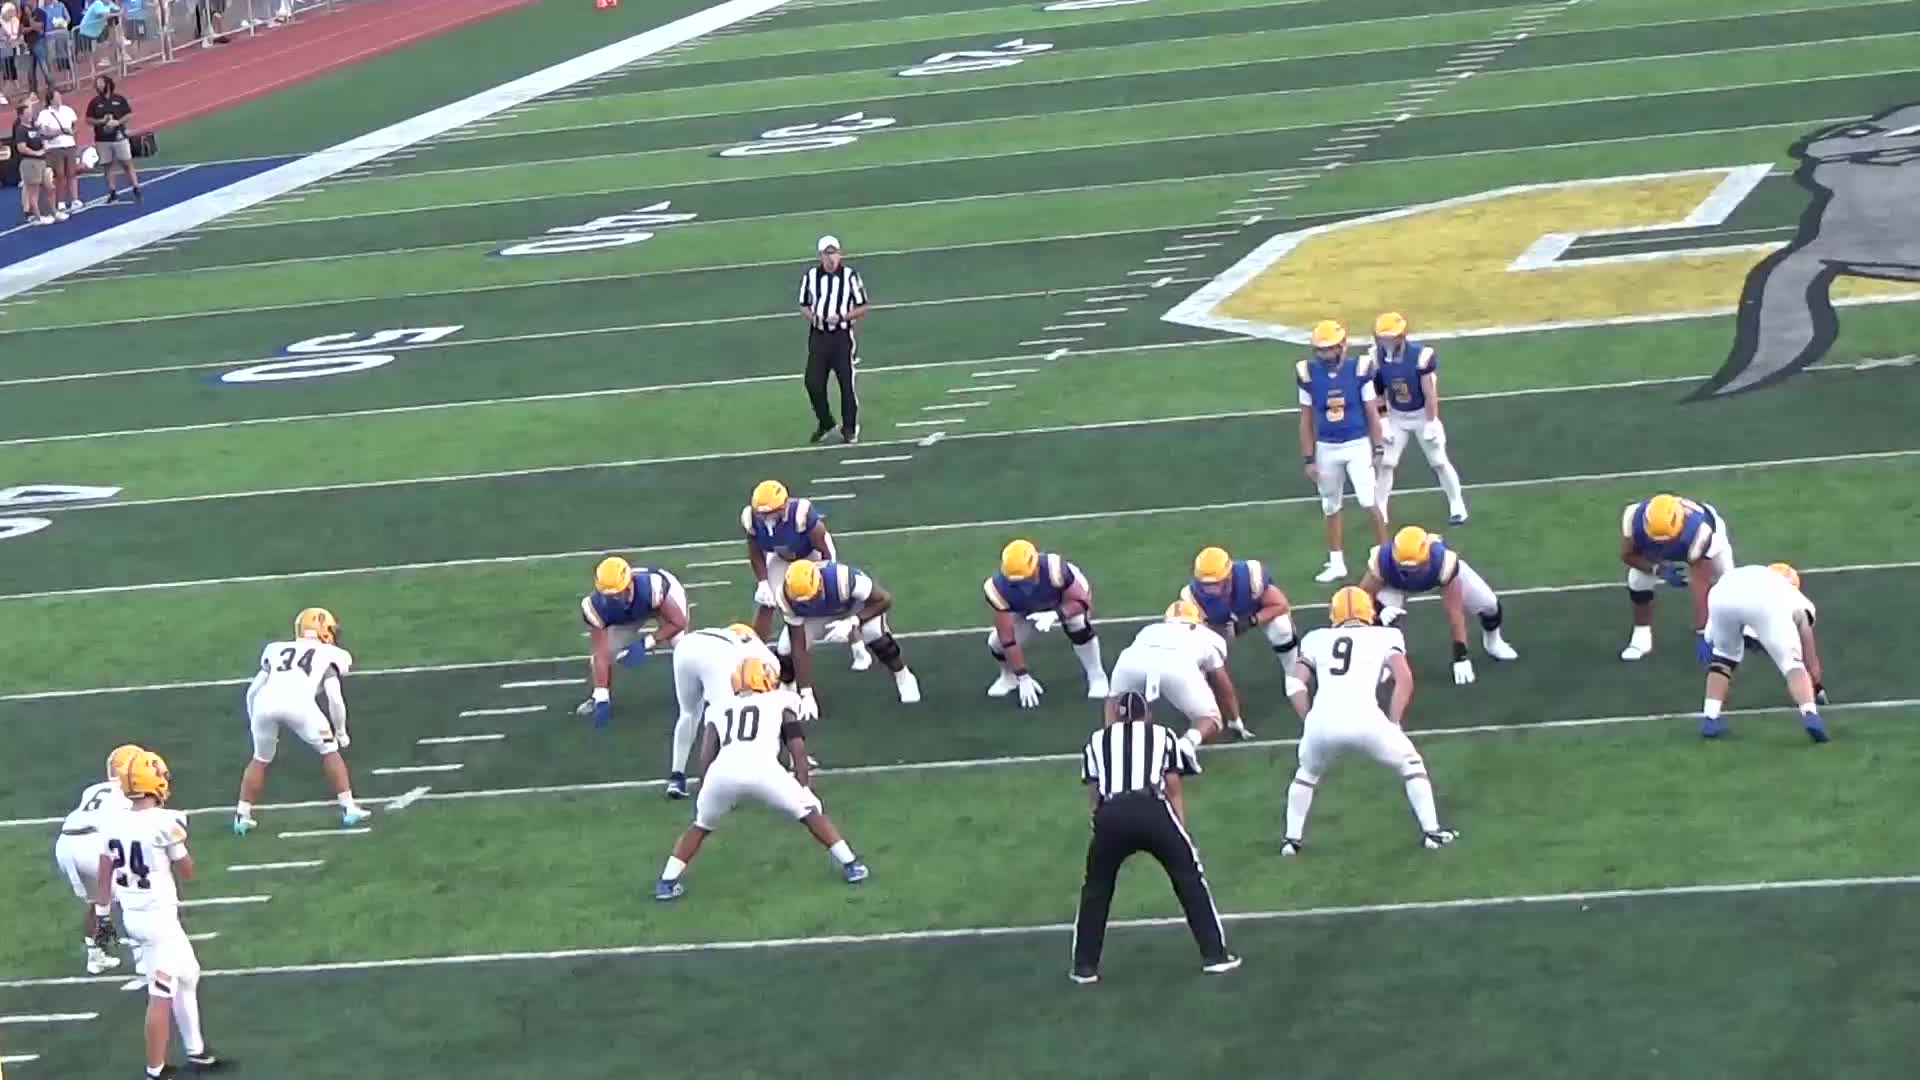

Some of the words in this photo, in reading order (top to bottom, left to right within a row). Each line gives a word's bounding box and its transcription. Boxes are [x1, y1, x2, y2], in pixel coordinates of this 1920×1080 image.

[222, 325, 465, 382] 50
[276, 647, 316, 677] 34
[1329, 636, 1354, 676] 9
[722, 705, 760, 747] 10
[108, 838, 151, 890] 24
